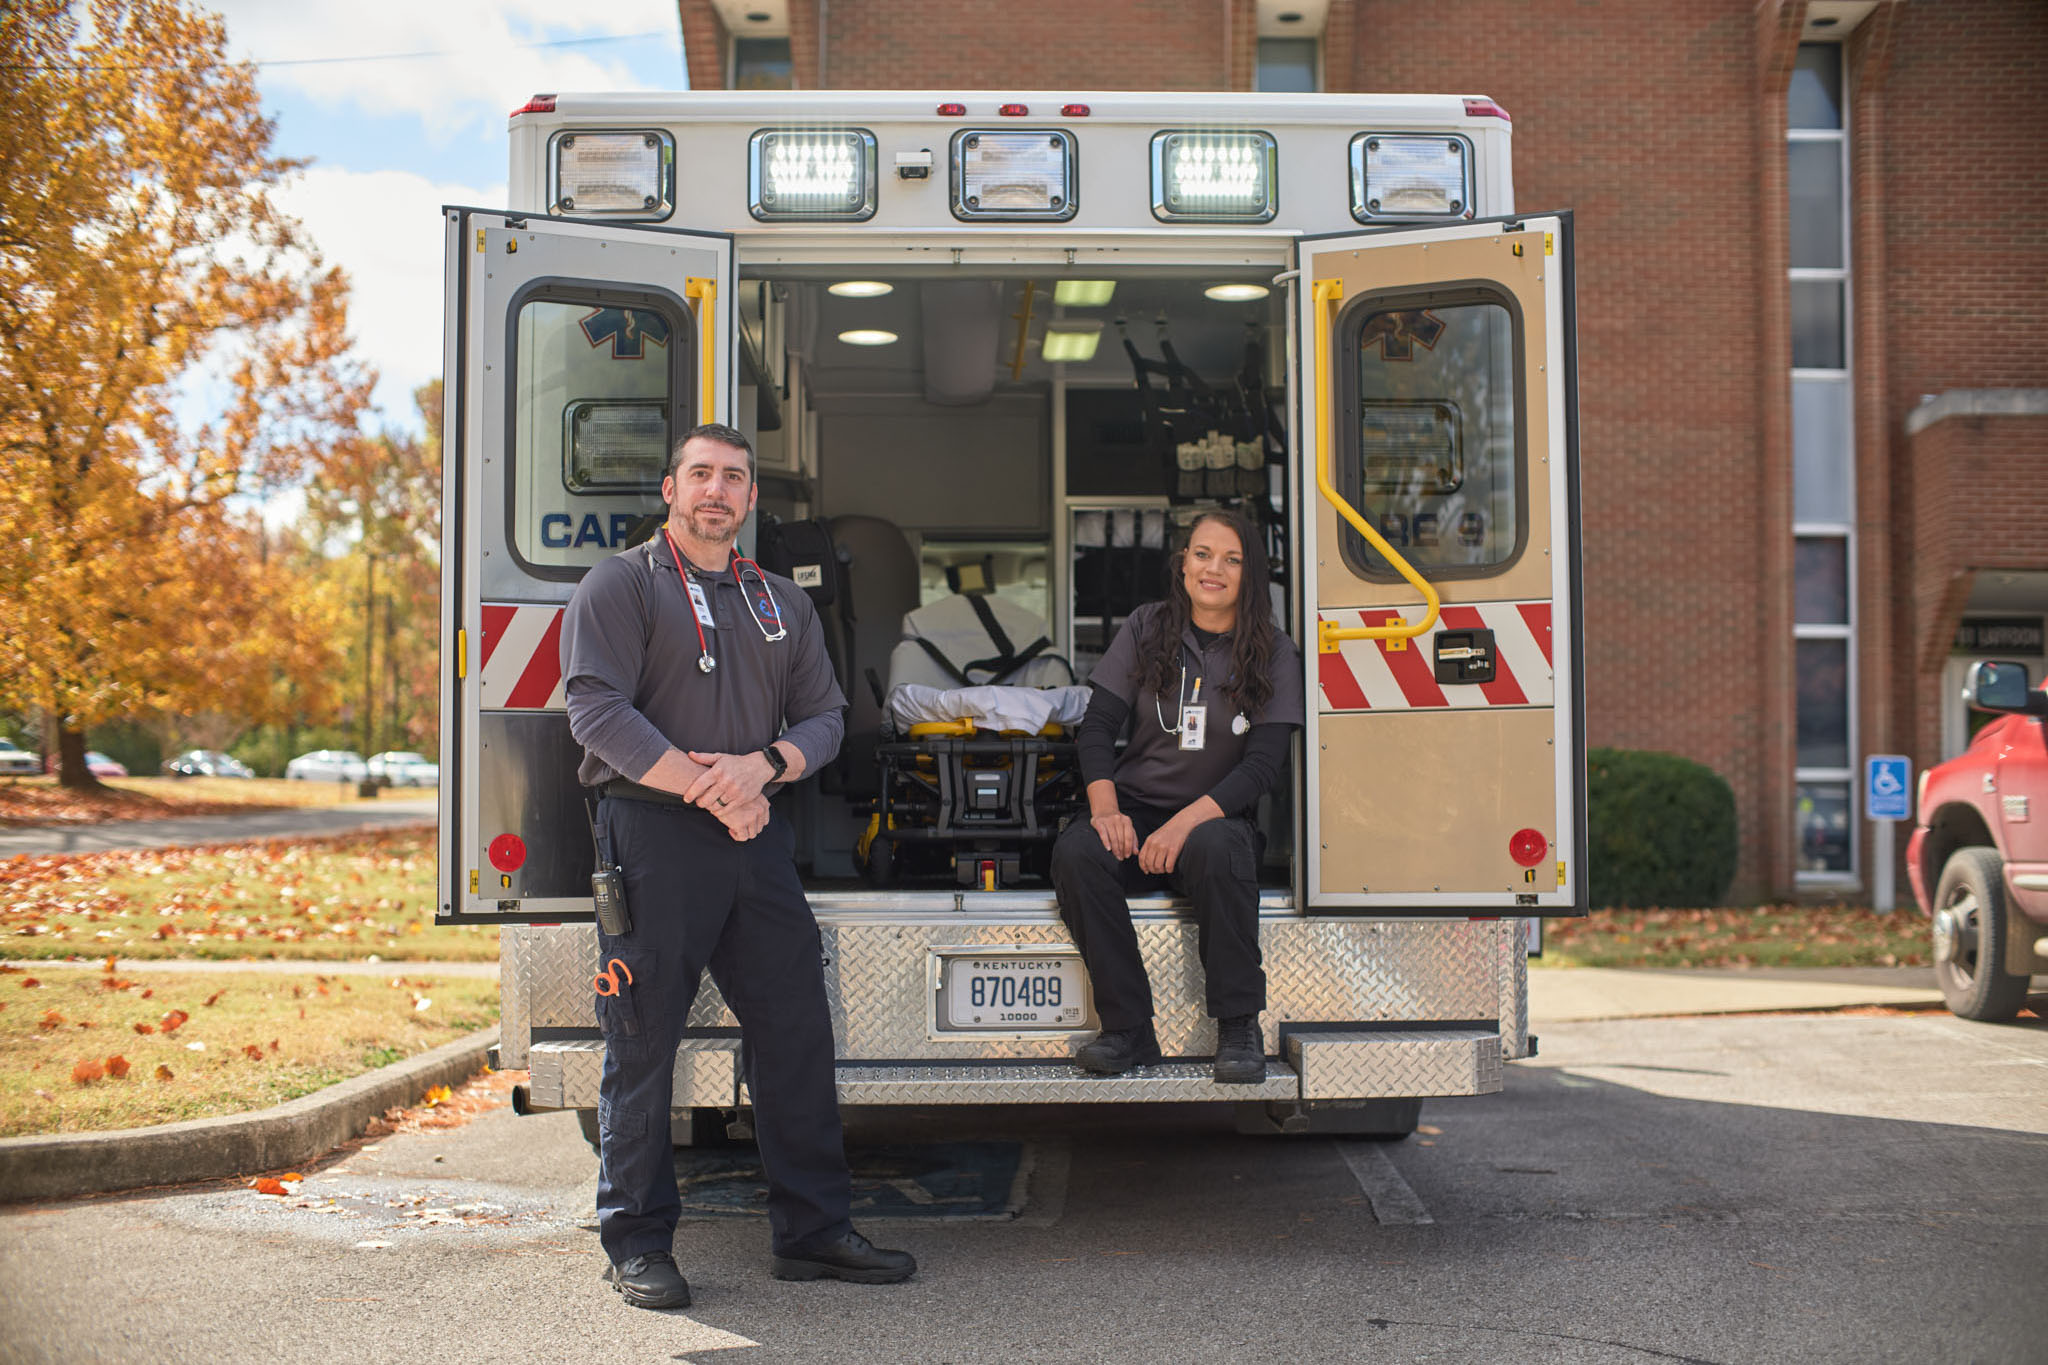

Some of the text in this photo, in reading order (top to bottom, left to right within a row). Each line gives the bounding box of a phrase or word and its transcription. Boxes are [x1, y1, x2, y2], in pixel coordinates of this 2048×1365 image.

[983, 961, 1053, 970] KENTUCKY
[971, 976, 1062, 1007] 870489
[1000, 1012, 1038, 1021] 10000
